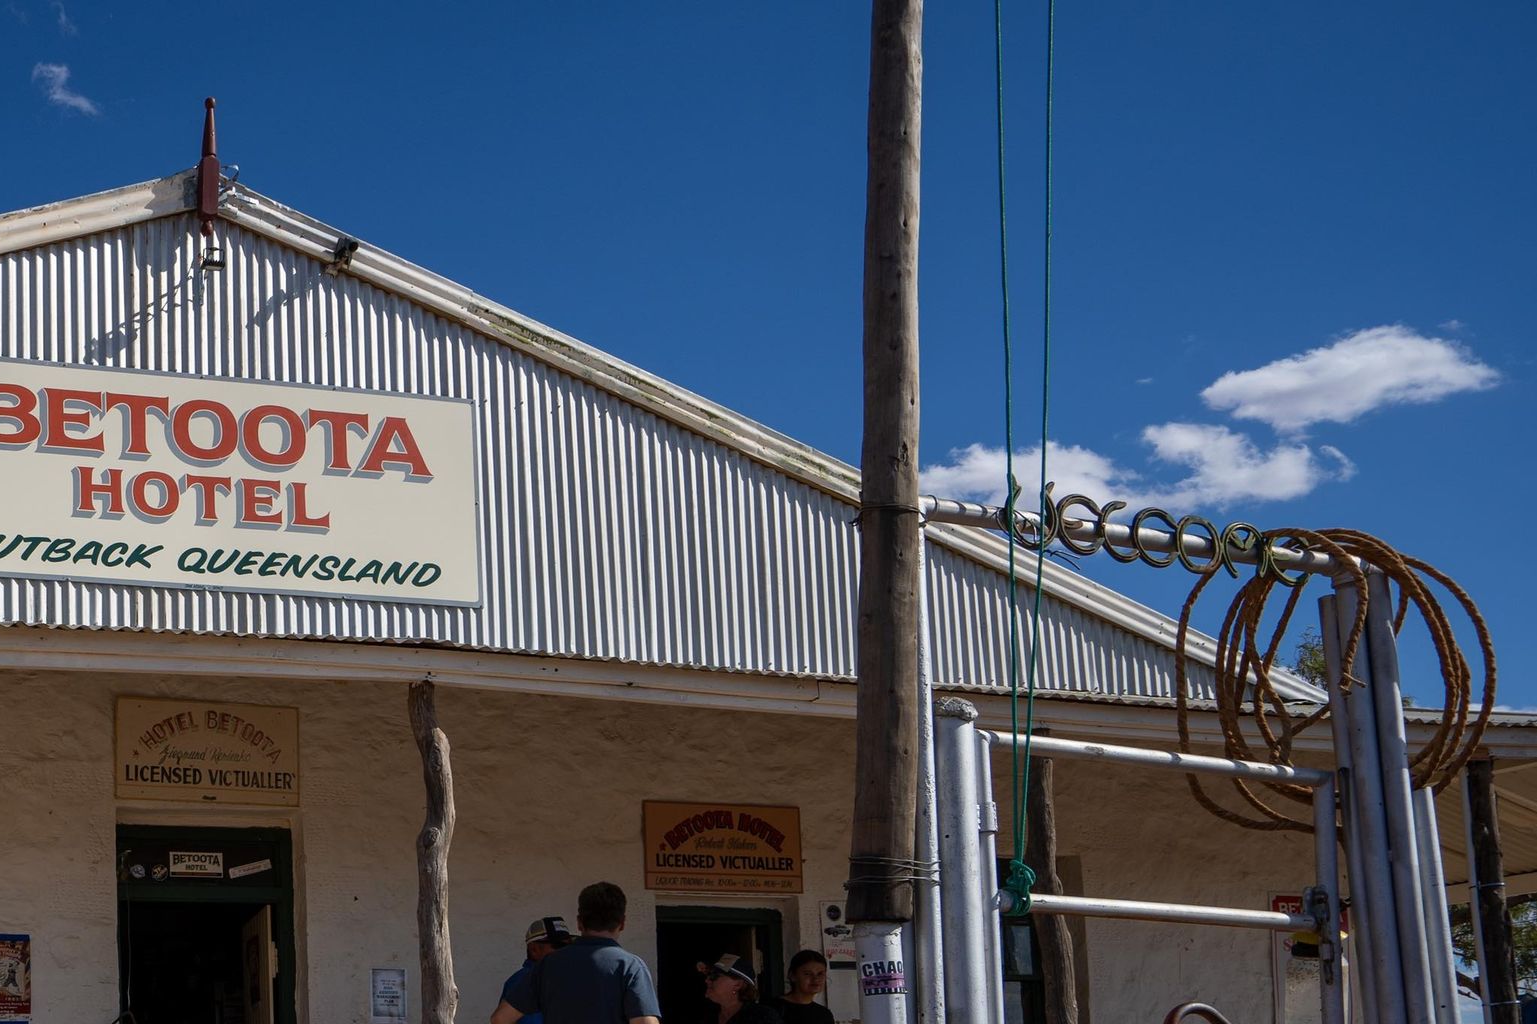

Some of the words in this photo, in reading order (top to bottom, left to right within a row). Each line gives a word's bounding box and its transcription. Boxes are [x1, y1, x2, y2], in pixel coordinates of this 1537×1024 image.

[71, 466, 331, 532] HOTEL
[178, 547, 442, 588] QUEENSLAND
[138, 711, 199, 750] HOTEL
[206, 710, 282, 765] BETOOTA
[125, 764, 202, 785] LICENSED
[208, 769, 293, 790] VICTUALLER
[664, 810, 734, 850] BETOOTA
[737, 813, 786, 853] HOTEL
[173, 854, 221, 866] BETOOTA
[656, 854, 715, 868] LICENSED
[720, 856, 794, 871] VICTUALLER
